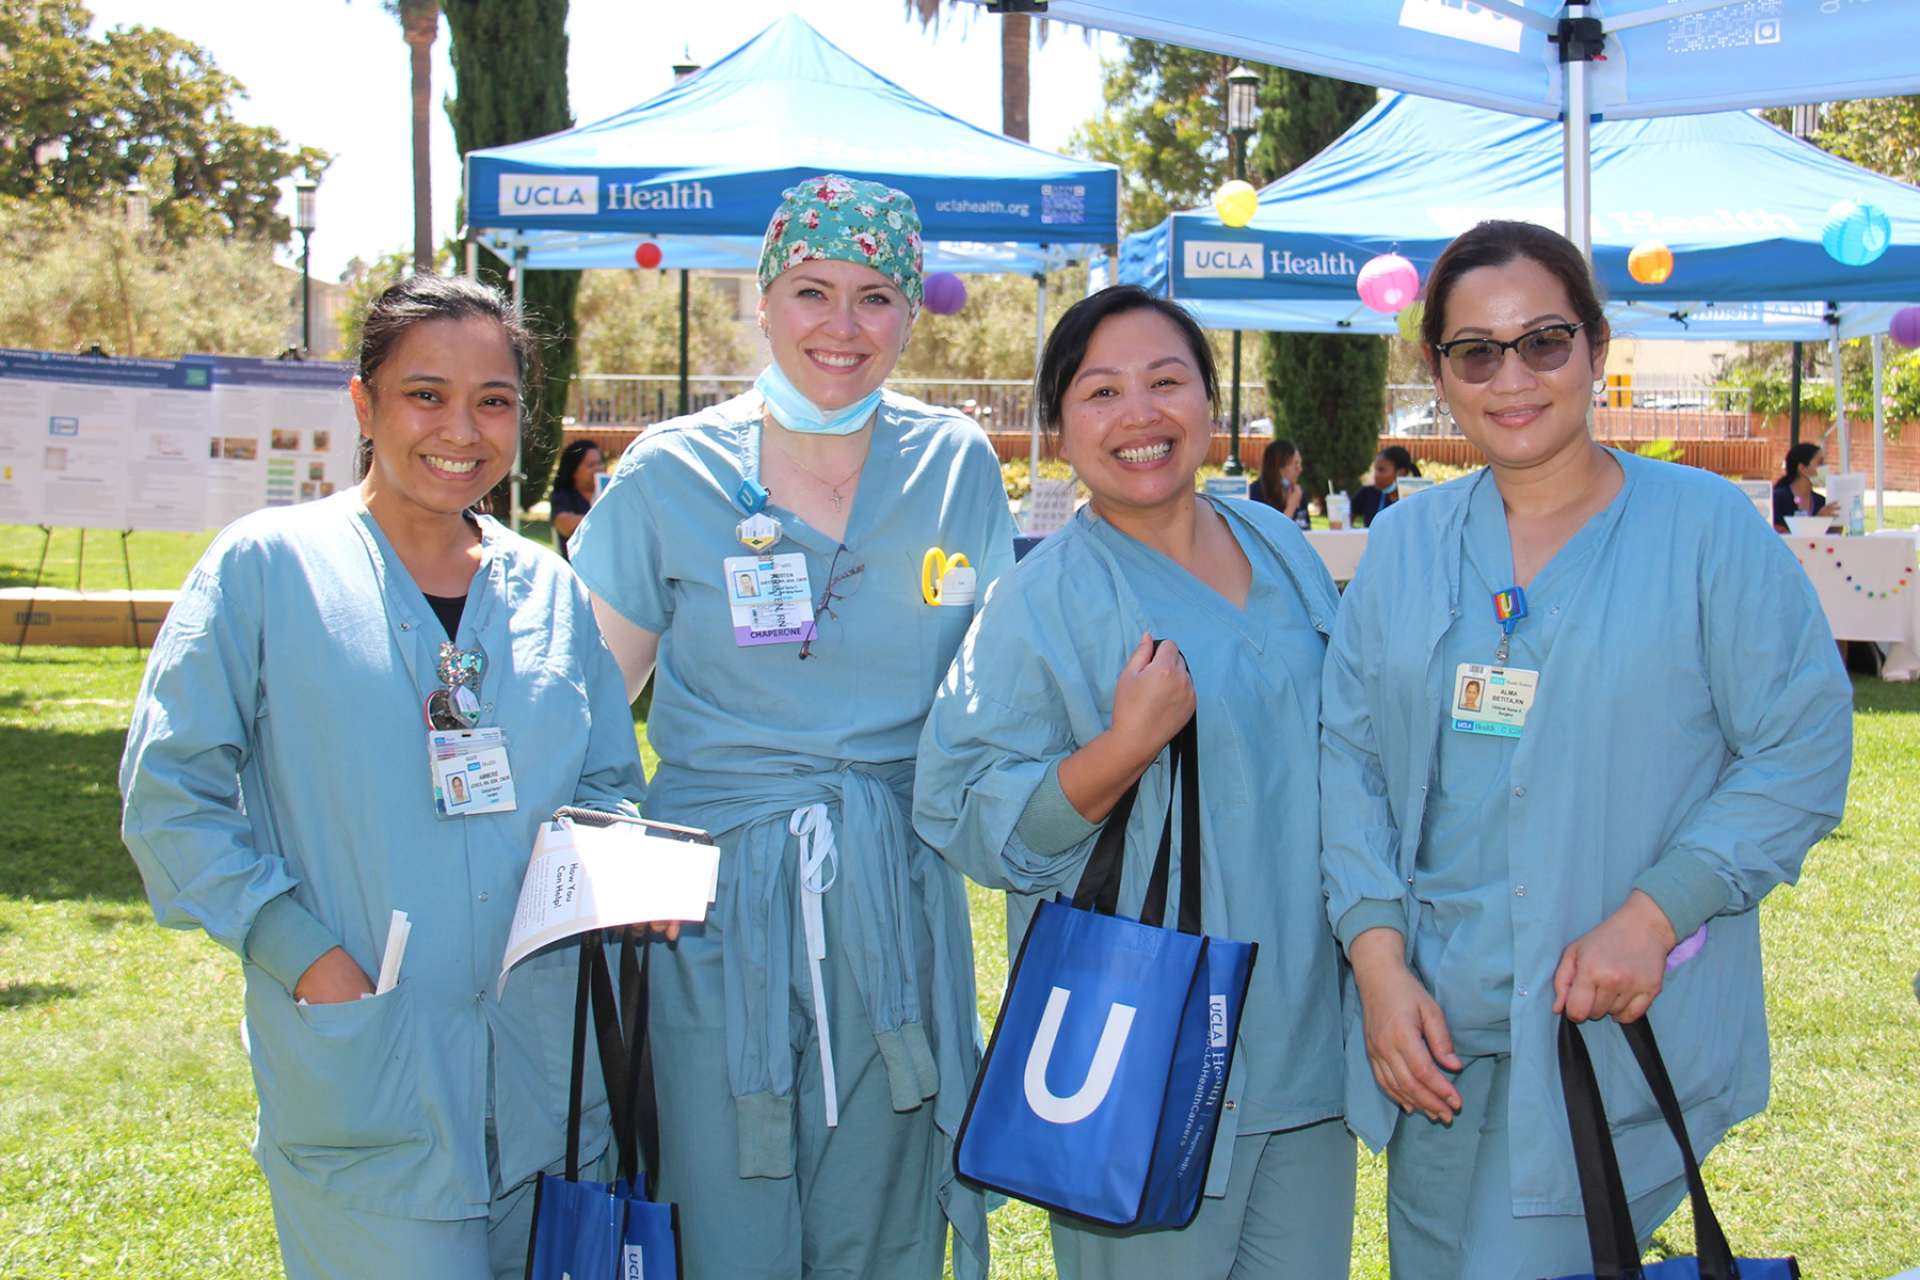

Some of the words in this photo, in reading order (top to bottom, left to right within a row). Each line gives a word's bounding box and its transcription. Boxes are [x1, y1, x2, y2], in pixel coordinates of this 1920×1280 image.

[513, 185, 585, 206] UCLA
[607, 182, 714, 210] Health
[935, 200, 1030, 217] uclahealth.org
[1195, 250, 1254, 269] UCLA
[1270, 250, 1356, 275] Health
[750, 627, 802, 639] CHAPERONE
[1500, 689, 1518, 697] ALMA
[556, 865, 566, 884] Can
[569, 863, 579, 882] How
[566, 883, 576, 902] You
[1209, 1002, 1224, 1041] UCLA
[1024, 986, 1137, 1124] U
